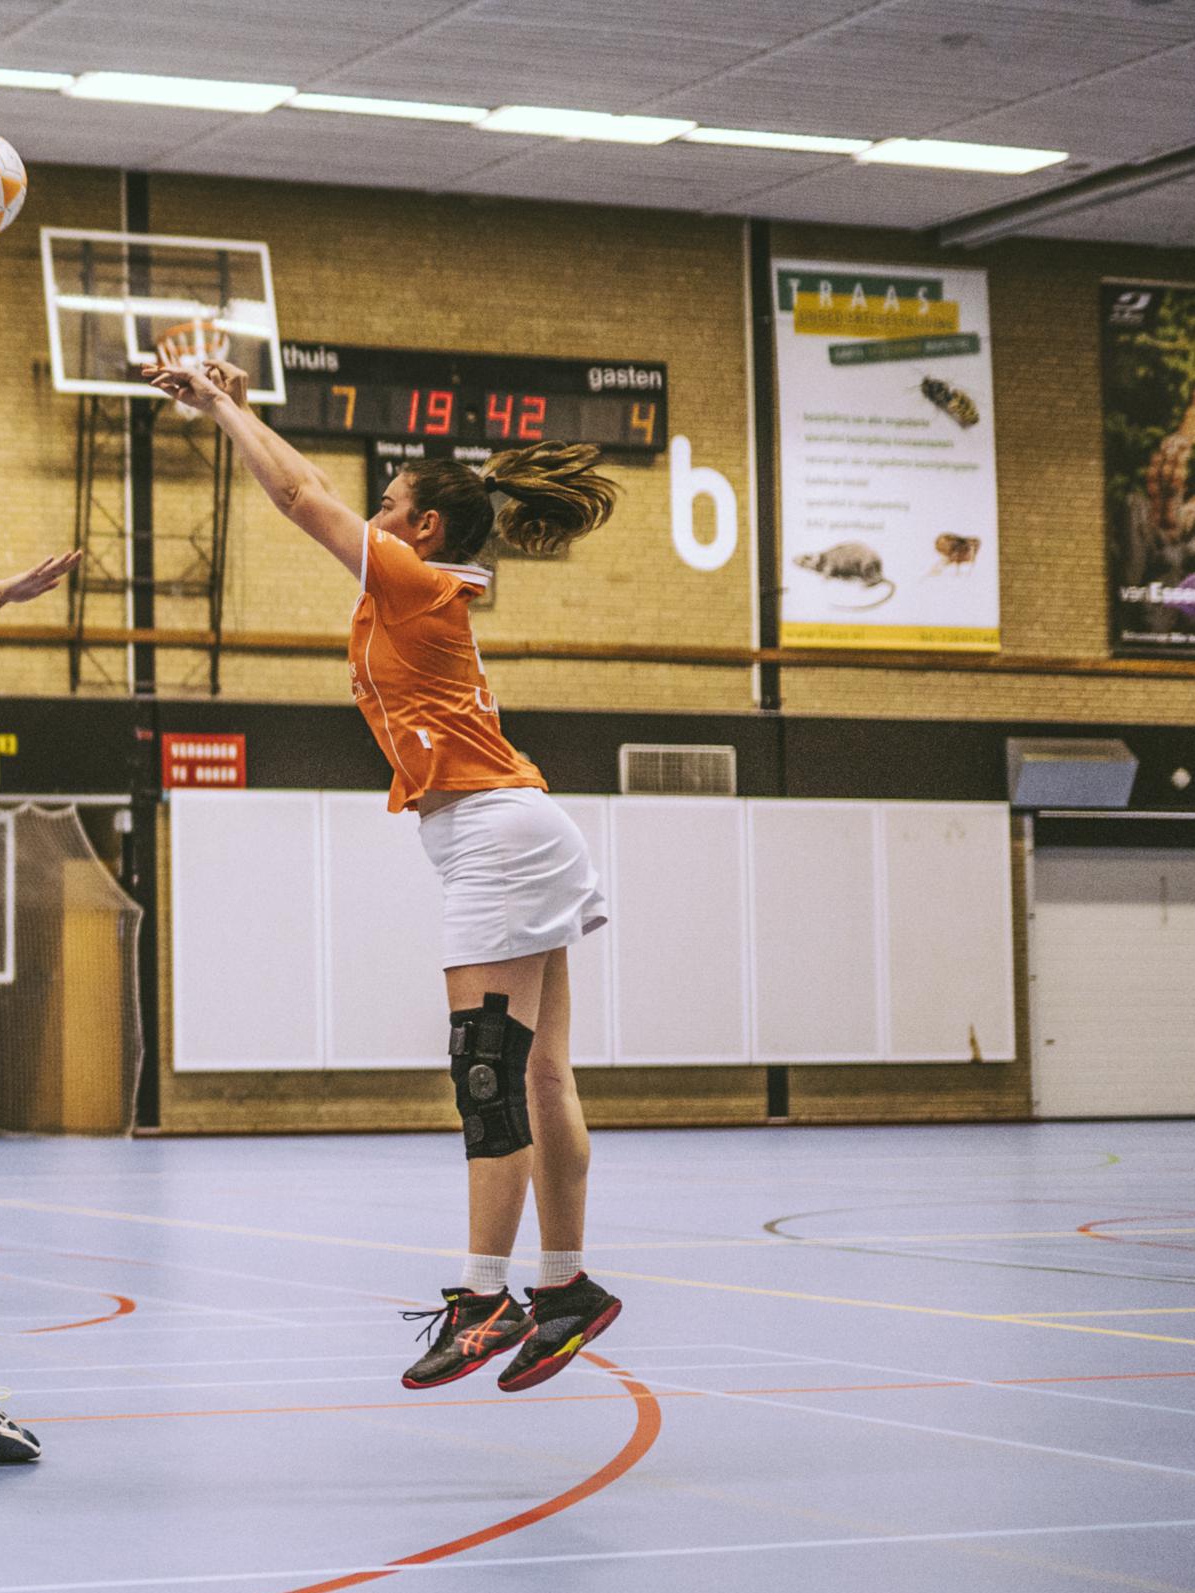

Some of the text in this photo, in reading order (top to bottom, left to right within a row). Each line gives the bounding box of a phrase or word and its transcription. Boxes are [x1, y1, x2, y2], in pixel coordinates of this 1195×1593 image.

[789, 277, 930, 316] TRAAS
[283, 344, 663, 392] thuis gasten
[330, 385, 656, 446] 7 19 42 4
[671, 434, 738, 571] b
